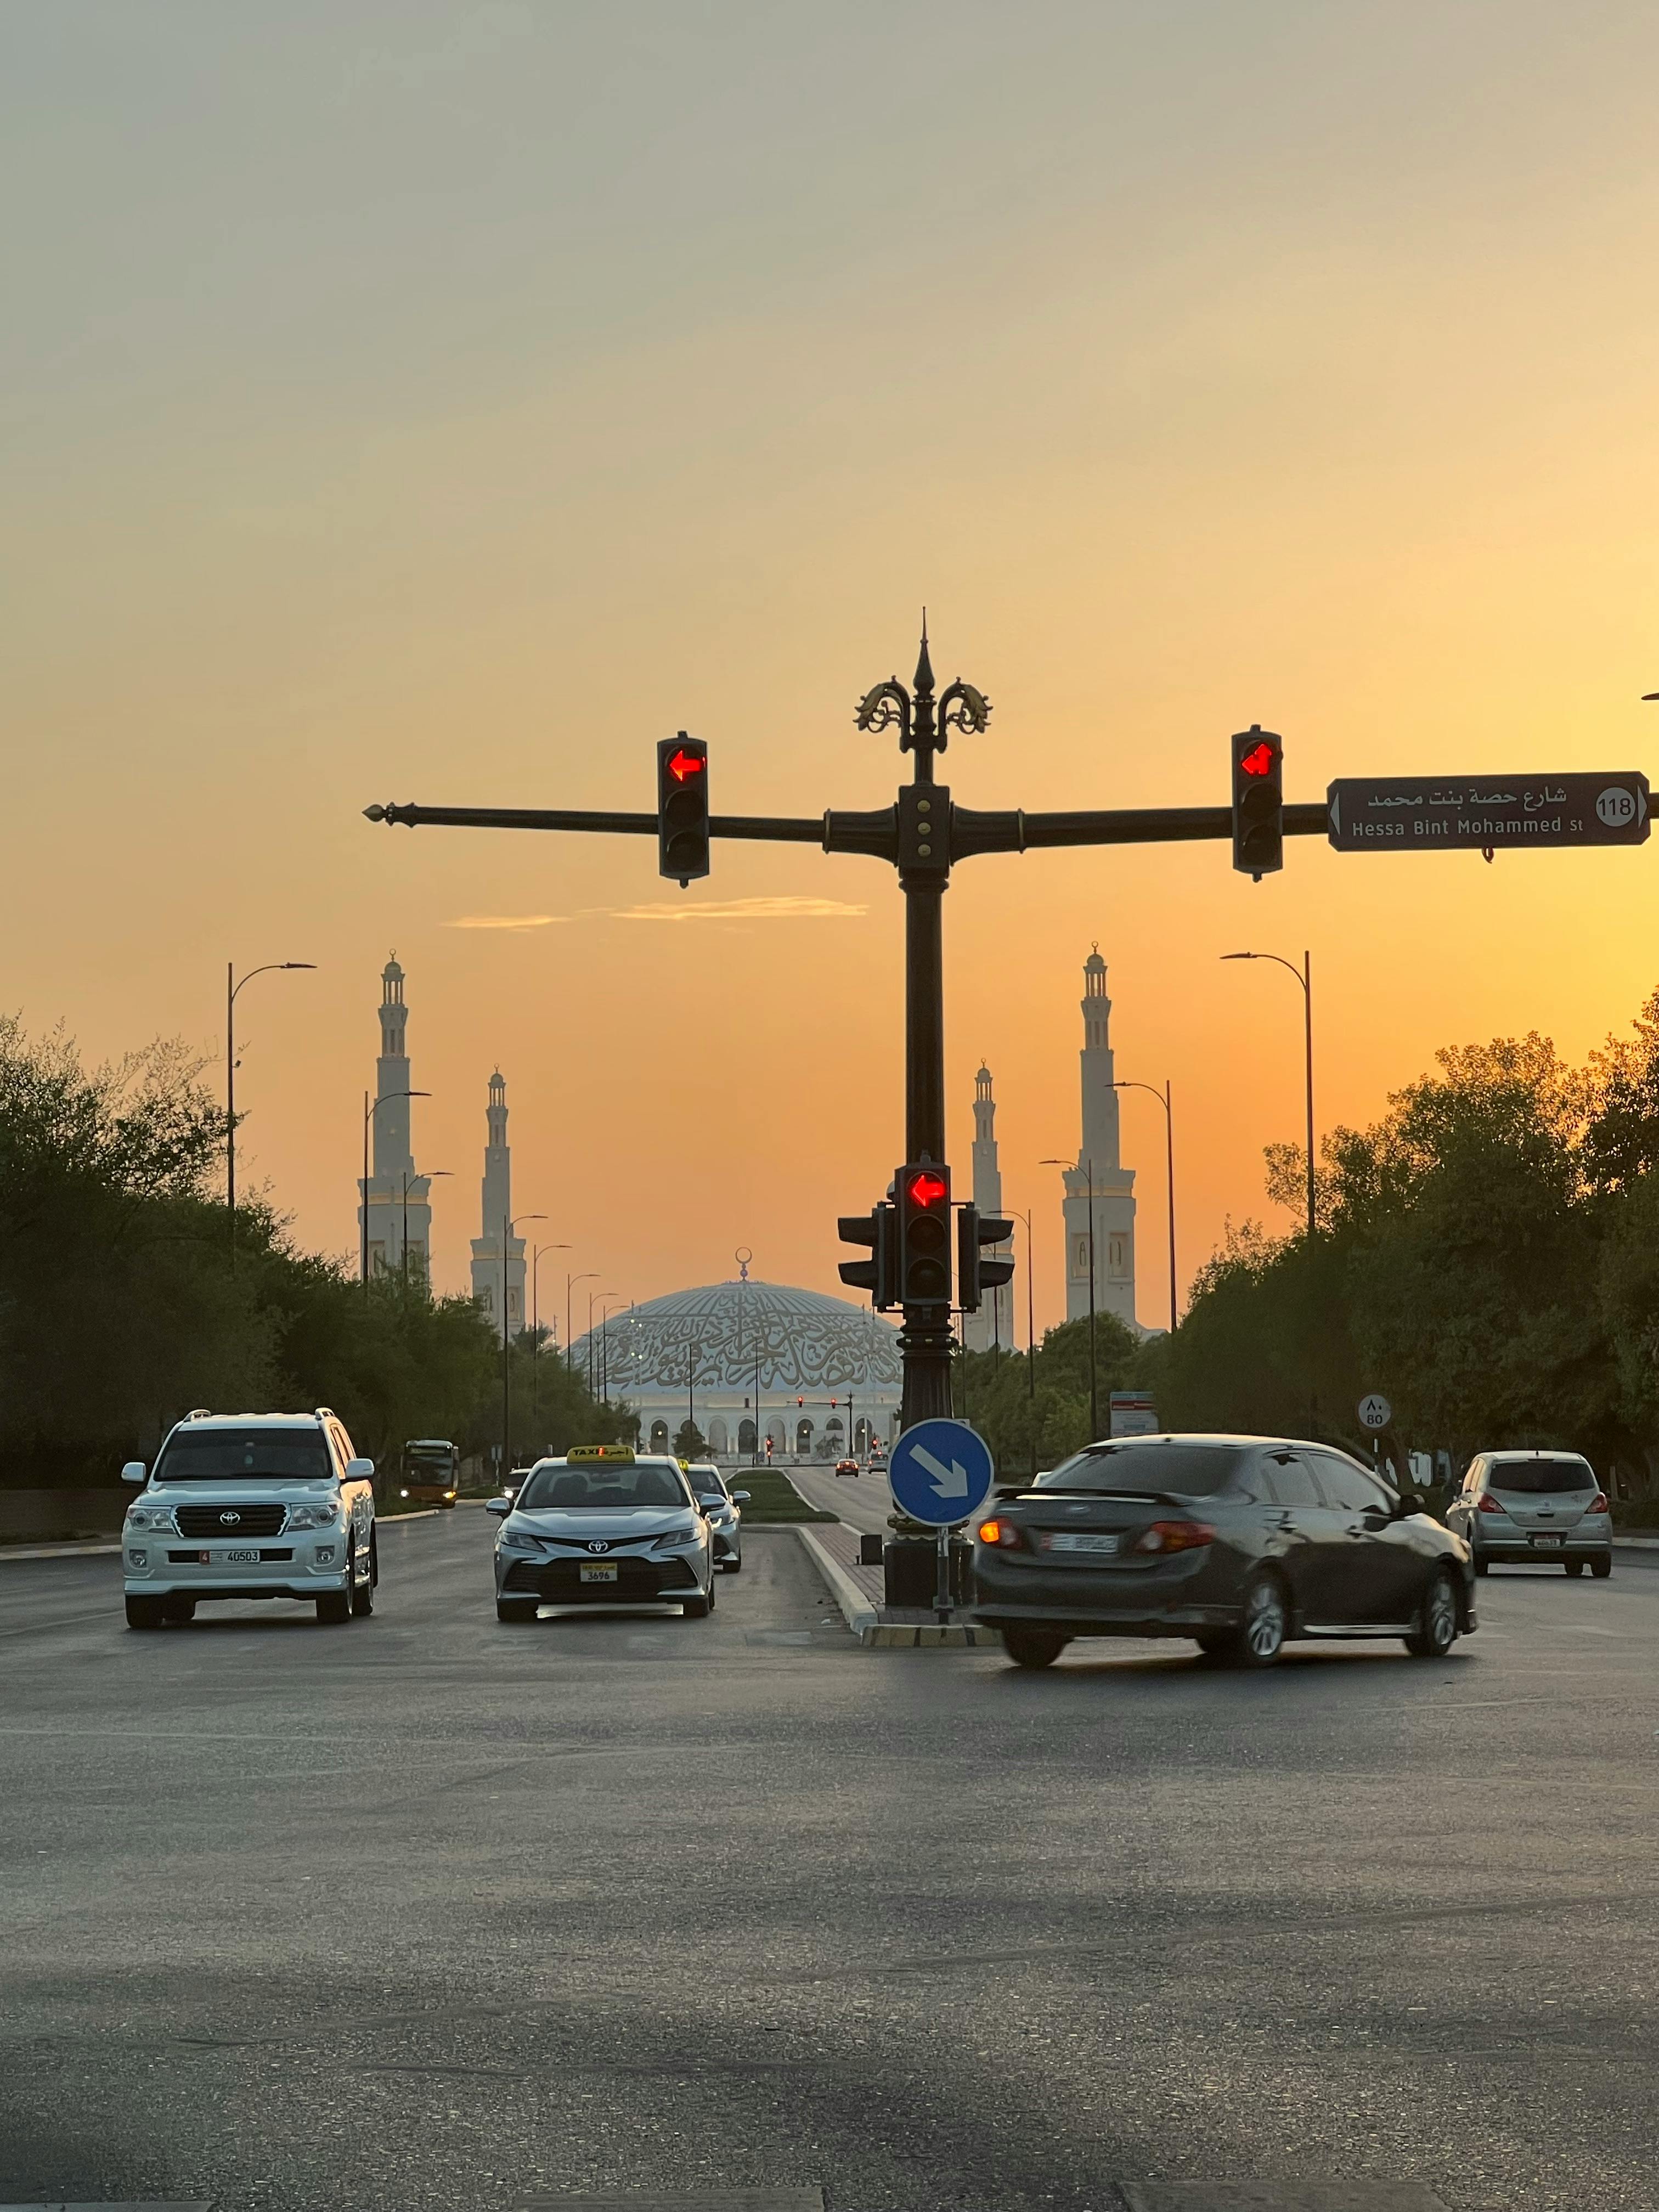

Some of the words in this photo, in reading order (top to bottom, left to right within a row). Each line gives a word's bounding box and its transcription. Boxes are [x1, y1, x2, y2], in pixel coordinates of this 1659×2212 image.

[1368, 795, 1424, 806] محمد
[1429, 791, 1464, 810] بنت
[1469, 788, 1517, 804] حصة
[1523, 786, 1567, 811] شارع
[1599, 797, 1632, 816] 118
[1353, 822, 1404, 837] Hessa
[1414, 820, 1449, 836] Bint
[1458, 816, 1561, 834] Mohammed
[1367, 1414, 1383, 1425] 80
[227, 1551, 258, 1561] 40503
